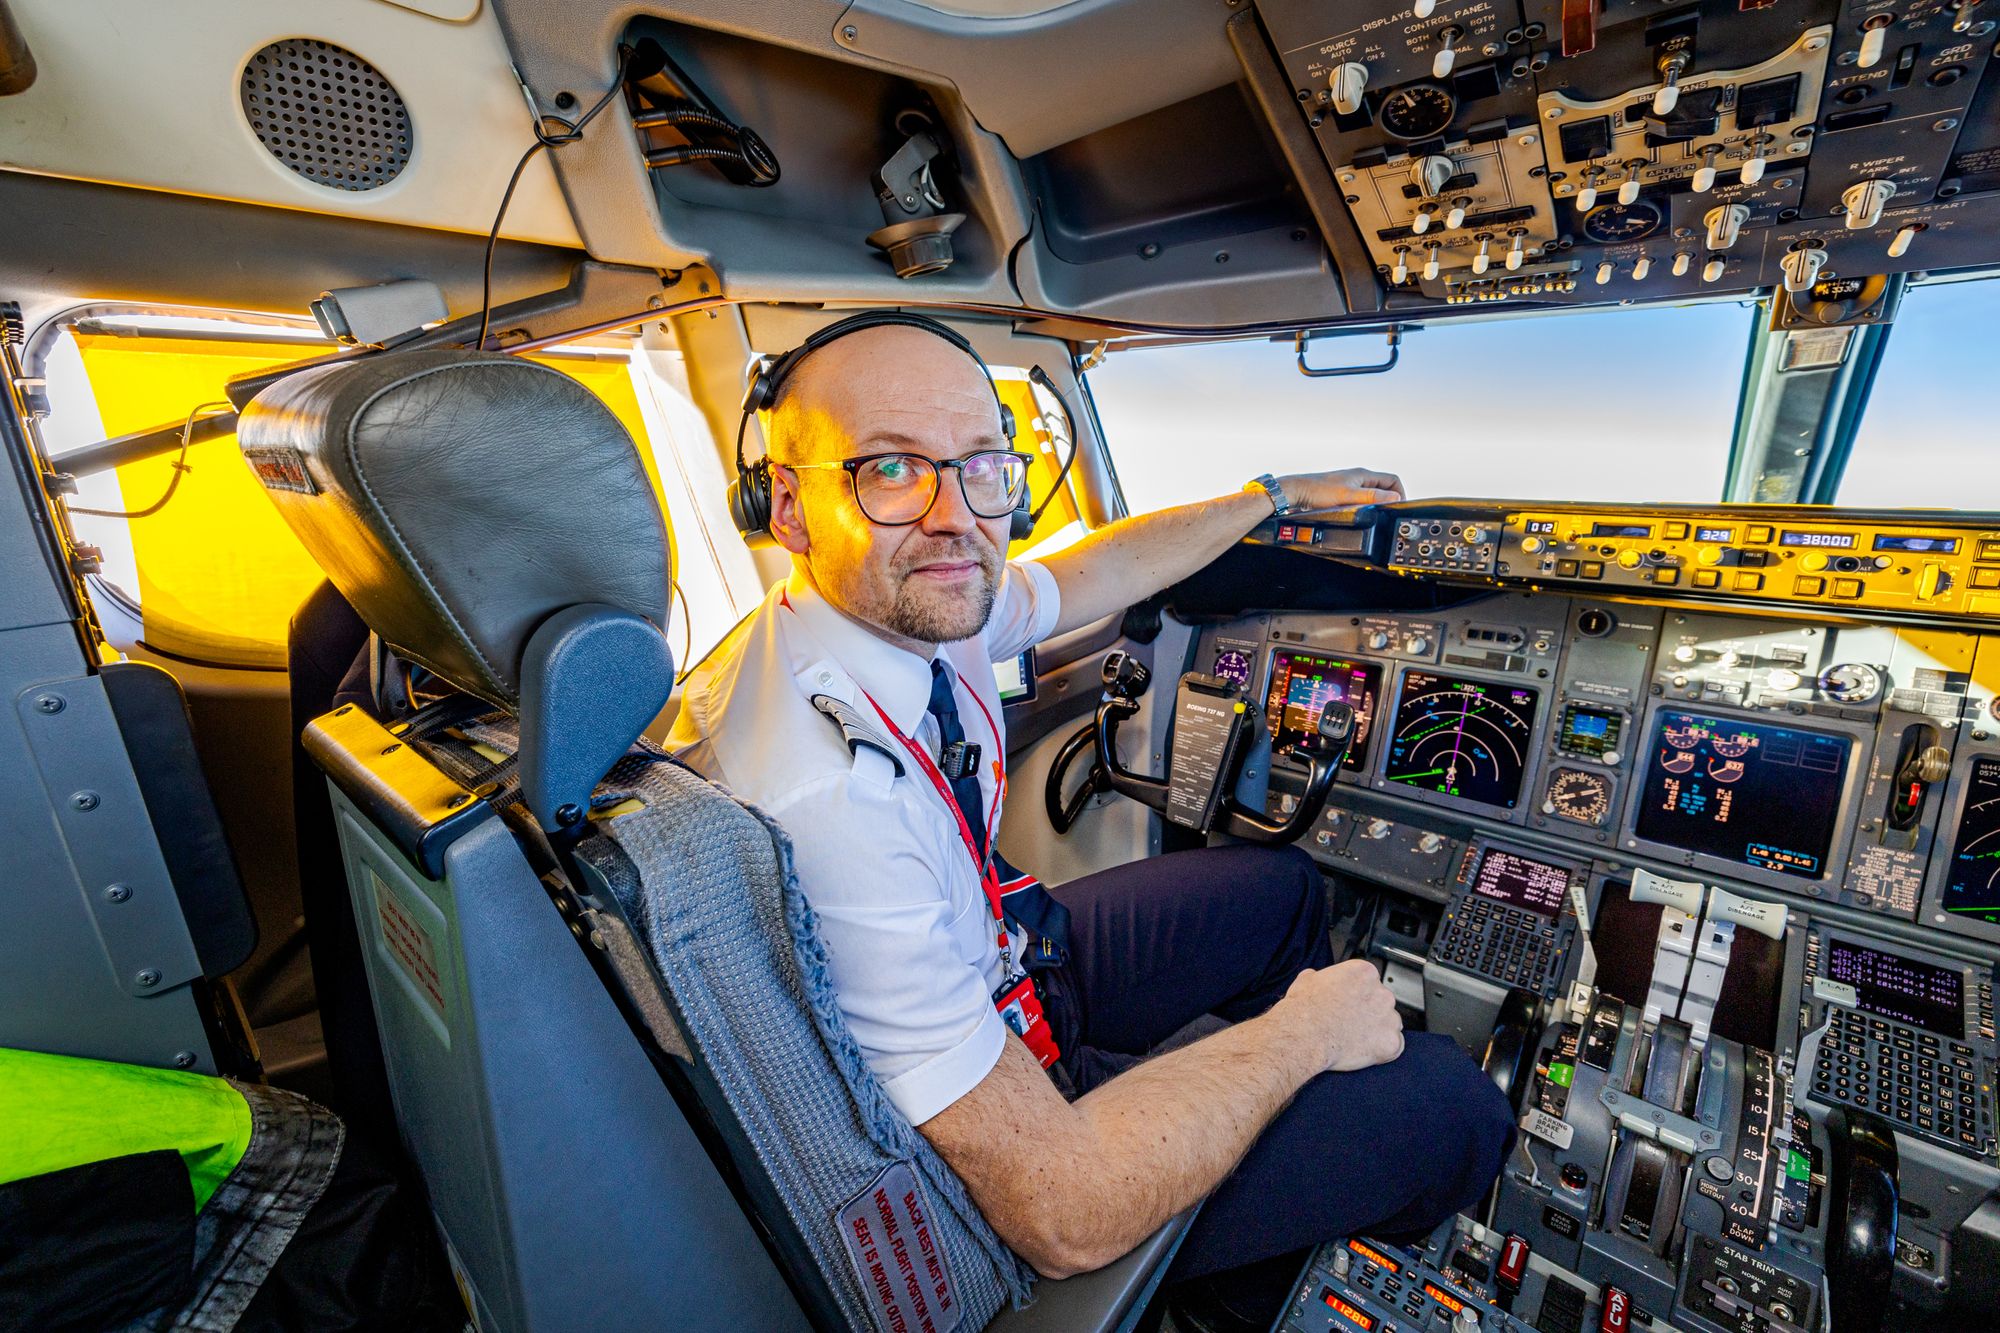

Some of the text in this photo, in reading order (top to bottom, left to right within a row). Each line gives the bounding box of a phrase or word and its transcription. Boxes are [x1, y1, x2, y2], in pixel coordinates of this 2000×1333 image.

[1362, 10, 1412, 32] DISPLAYS
[1404, 2, 1492, 34] CONTROL PANEL
[1470, 14, 1495, 26] BOTH
[1474, 26, 1487, 35] ON
[1320, 38, 1357, 54] SOURCE
[1406, 34, 1430, 46] BOTH
[1330, 48, 1352, 58] AUTO
[1365, 44, 1382, 54] ALL
[1412, 45, 1424, 54] ON
[1940, 44, 1973, 56] GRD
[1367, 54, 1379, 62] ON
[1931, 52, 1974, 66] CALL
[1308, 62, 1323, 70] ALL
[1312, 70, 1322, 78] ON
[1828, 70, 1888, 88] ATTEND
[1862, 156, 1904, 167] WIPER
[1647, 164, 1696, 177] APU GEN
[1860, 166, 1889, 174] PARK
[1899, 166, 1918, 174] INT
[1660, 173, 1682, 182] APU
[1723, 182, 1760, 193] WIPER
[1717, 191, 1742, 199] PARK
[1923, 202, 1968, 212] START
[1902, 216, 1932, 224] BOTH
[1531, 524, 1554, 532] 012
[1703, 530, 1728, 540] 329
[1802, 534, 1851, 546] 38000
[1187, 704, 1206, 713] BOEING
[1216, 710, 1226, 718] NG
[1867, 846, 1915, 860] LANDING GEAR
[1767, 861, 1784, 870] 2.9
[1650, 886, 1684, 898] DISENGAGE
[1728, 907, 1766, 921] DISENGAGE
[1820, 981, 1850, 993] FLAP
[1756, 1074, 1763, 1082] 2
[1755, 1088, 1762, 1096] 5
[1751, 1104, 1762, 1114] 10
[1536, 1119, 1560, 1133] BRAKE
[1538, 1114, 1568, 1131] PARKING
[1920, 1118, 1930, 1126] DEL
[1534, 1124, 1556, 1140] PULL
[1748, 1125, 1759, 1136] 15
[1743, 1149, 1758, 1160] 25
[1736, 1172, 1754, 1185] 30
[1700, 1181, 1718, 1193] HORN
[1700, 1186, 1726, 1201] CUTOUT
[1730, 1202, 1748, 1215] 40
[1550, 1217, 1572, 1231] BRAKE
[1554, 1212, 1572, 1225] PARK
[1623, 1214, 1650, 1230] CUTOFF
[1550, 1222, 1570, 1234] LIGHT
[1731, 1222, 1755, 1236] FLAP
[1729, 1228, 1755, 1244] DOWN
[874, 1187, 929, 1321] NORMAL FLIGHT POSITION
[904, 1190, 952, 1312] BACK REST MUST BE IN
[1507, 1240, 1522, 1269] 1
[852, 1216, 896, 1306] SEAT IS MOVING
[1714, 1260, 1728, 1269] ELECT
[1716, 1256, 1729, 1265] MAIN
[1723, 1246, 1776, 1276] STAB TRIM
[1741, 1270, 1767, 1286] NORMAL
[1300, 1285, 1312, 1302] NAV
[1444, 1280, 1474, 1299] STANDBY
[1778, 1286, 1793, 1296] AUTO
[1778, 1290, 1792, 1299] PILOT
[1343, 1288, 1366, 1306] ACTIVE
[1608, 1294, 1625, 1326] APU
[1334, 1320, 1349, 1332] TEST
[1742, 1320, 1754, 1330] CUT
